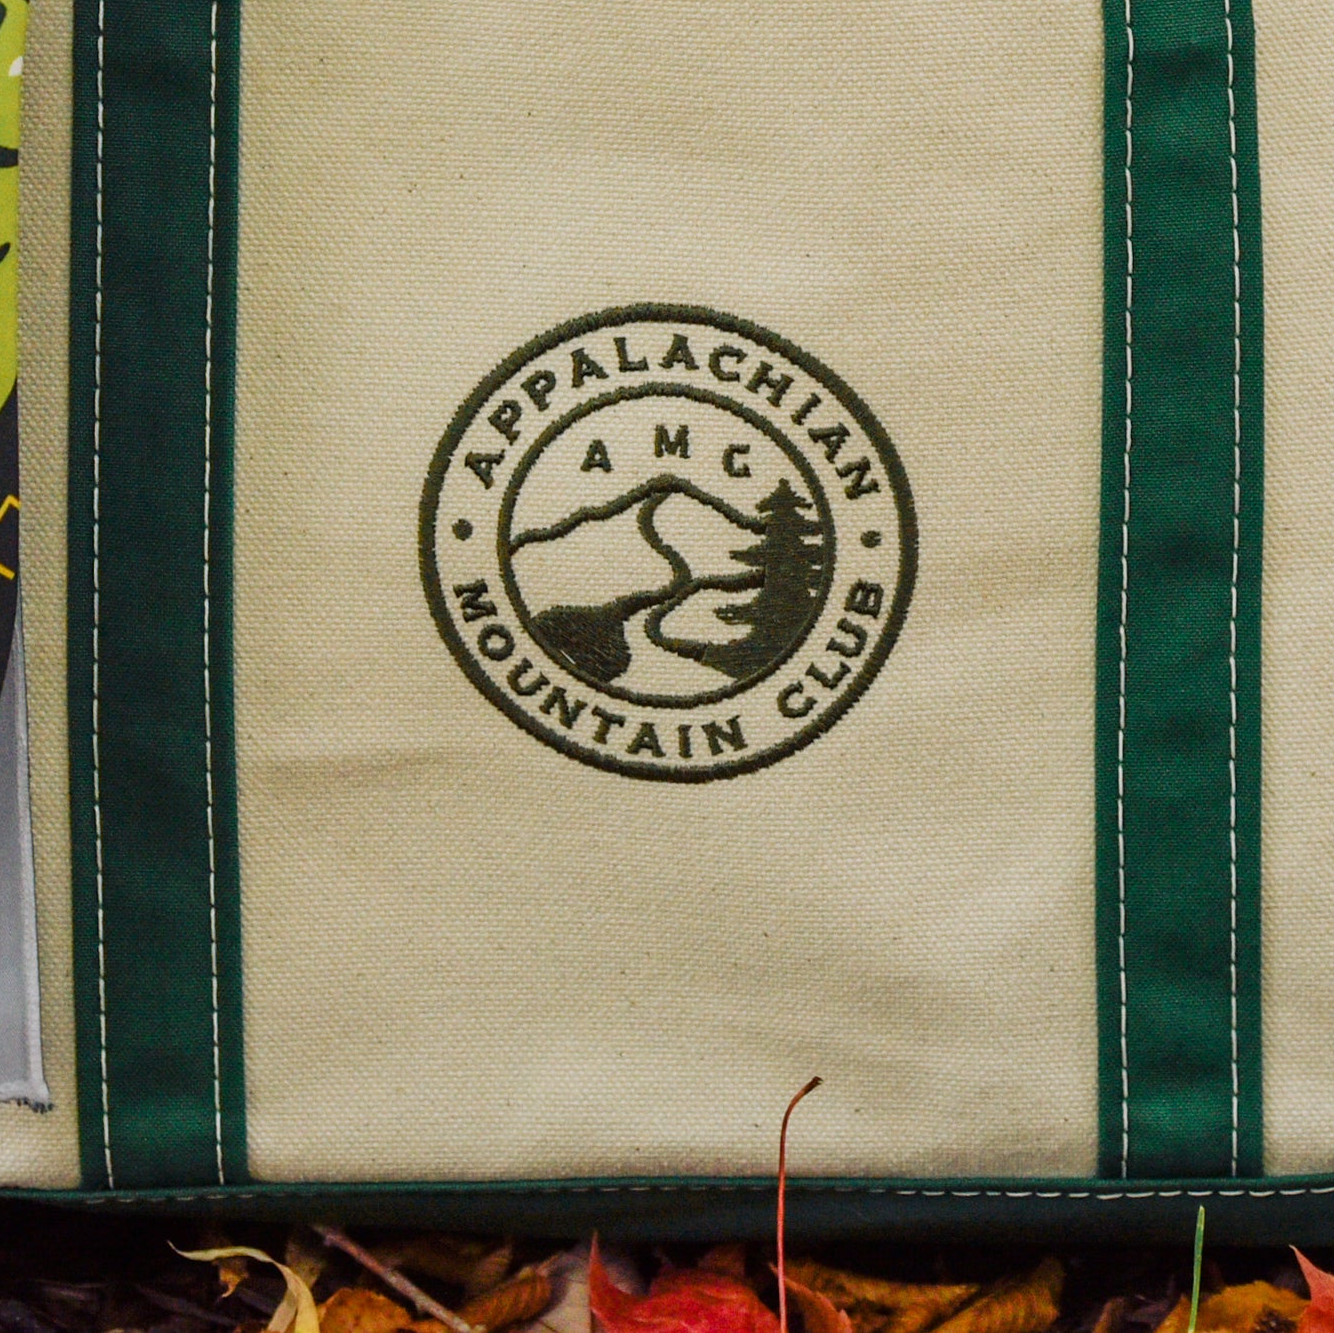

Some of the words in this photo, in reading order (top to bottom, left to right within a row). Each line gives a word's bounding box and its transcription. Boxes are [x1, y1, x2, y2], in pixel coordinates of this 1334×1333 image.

[465, 333, 881, 500] APPALACHIAN
[581, 424, 751, 477] AMC
[453, 578, 748, 758] MOUNTAIN
[776, 580, 885, 720] CLUB
